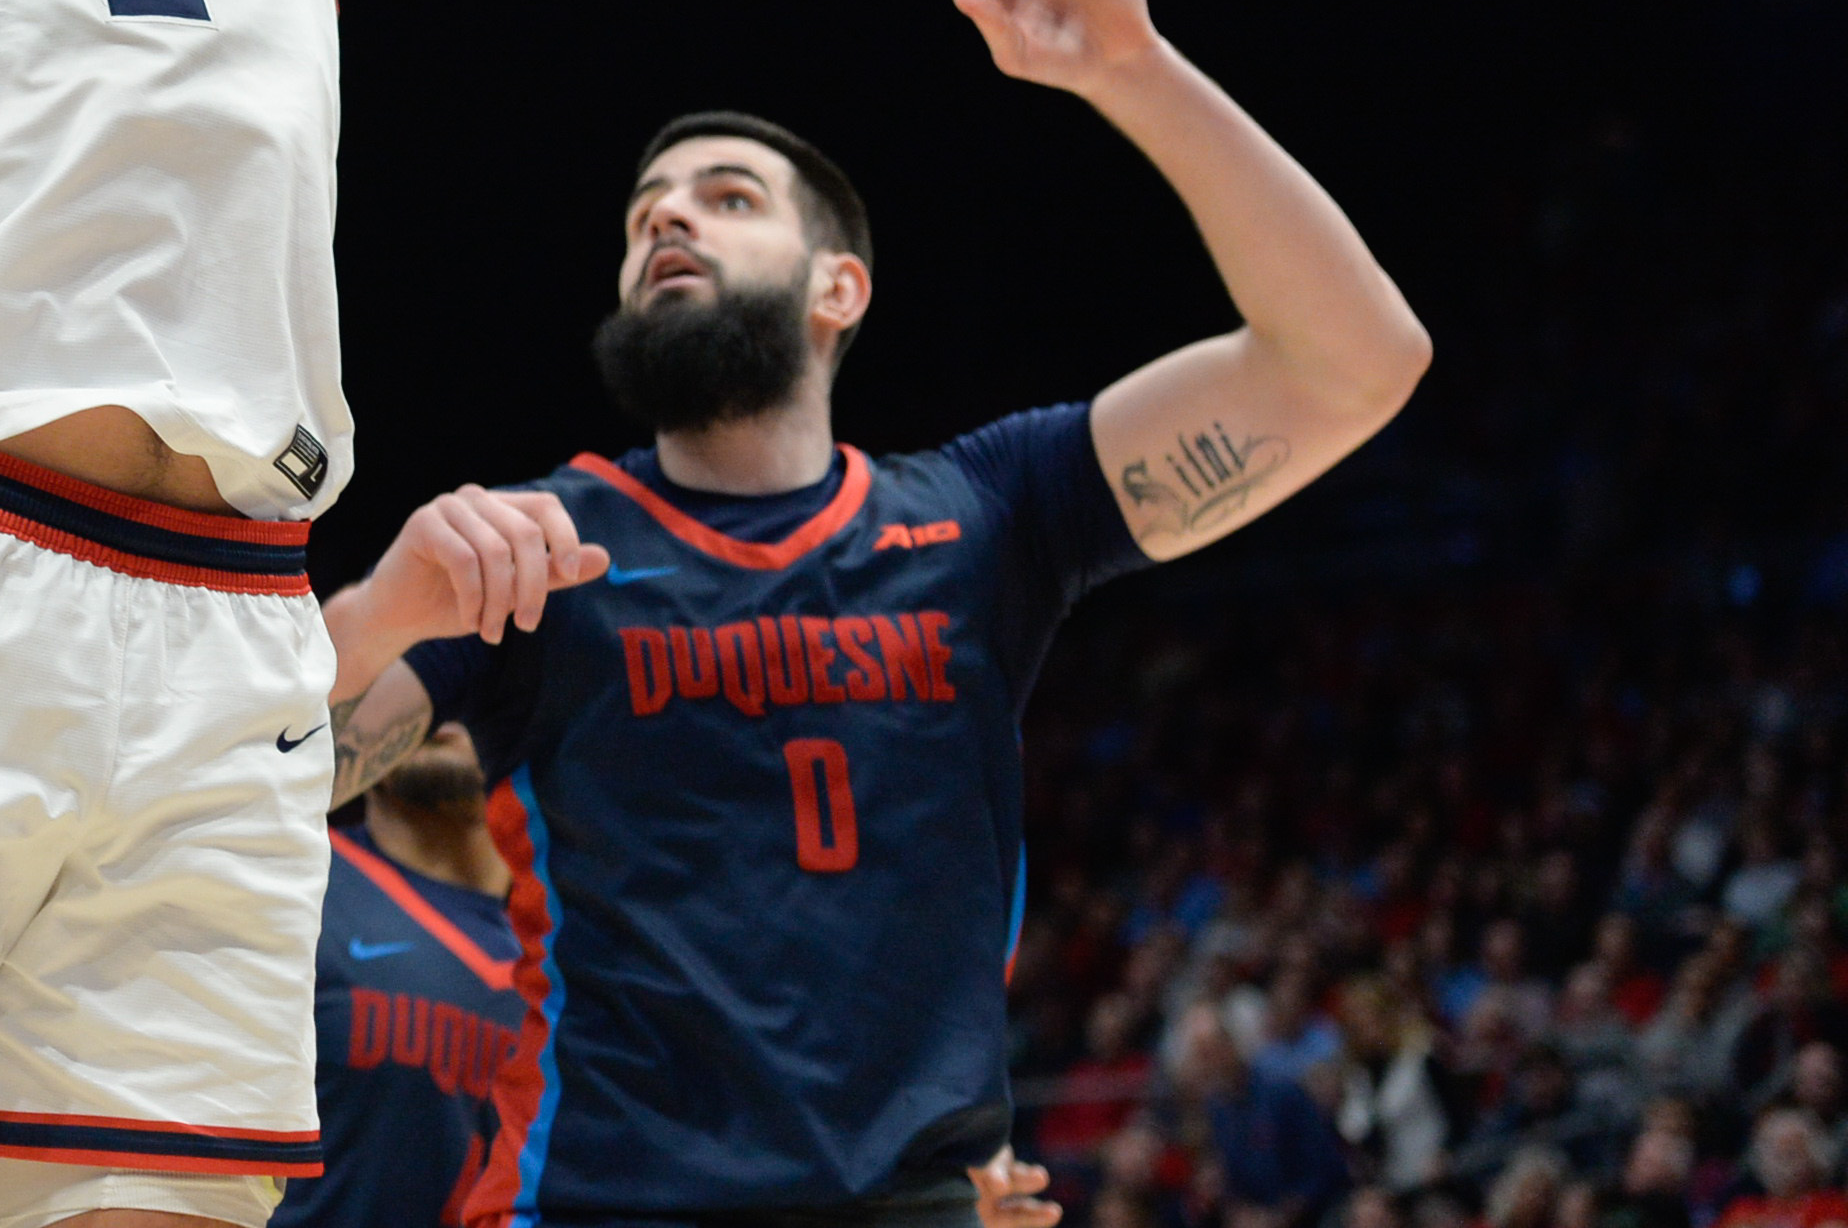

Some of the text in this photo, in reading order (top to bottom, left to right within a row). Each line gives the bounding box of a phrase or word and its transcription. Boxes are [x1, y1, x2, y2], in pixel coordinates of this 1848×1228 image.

[872, 519, 962, 552] A10
[618, 610, 957, 718] DUQUESNE
[783, 738, 859, 874] 0
